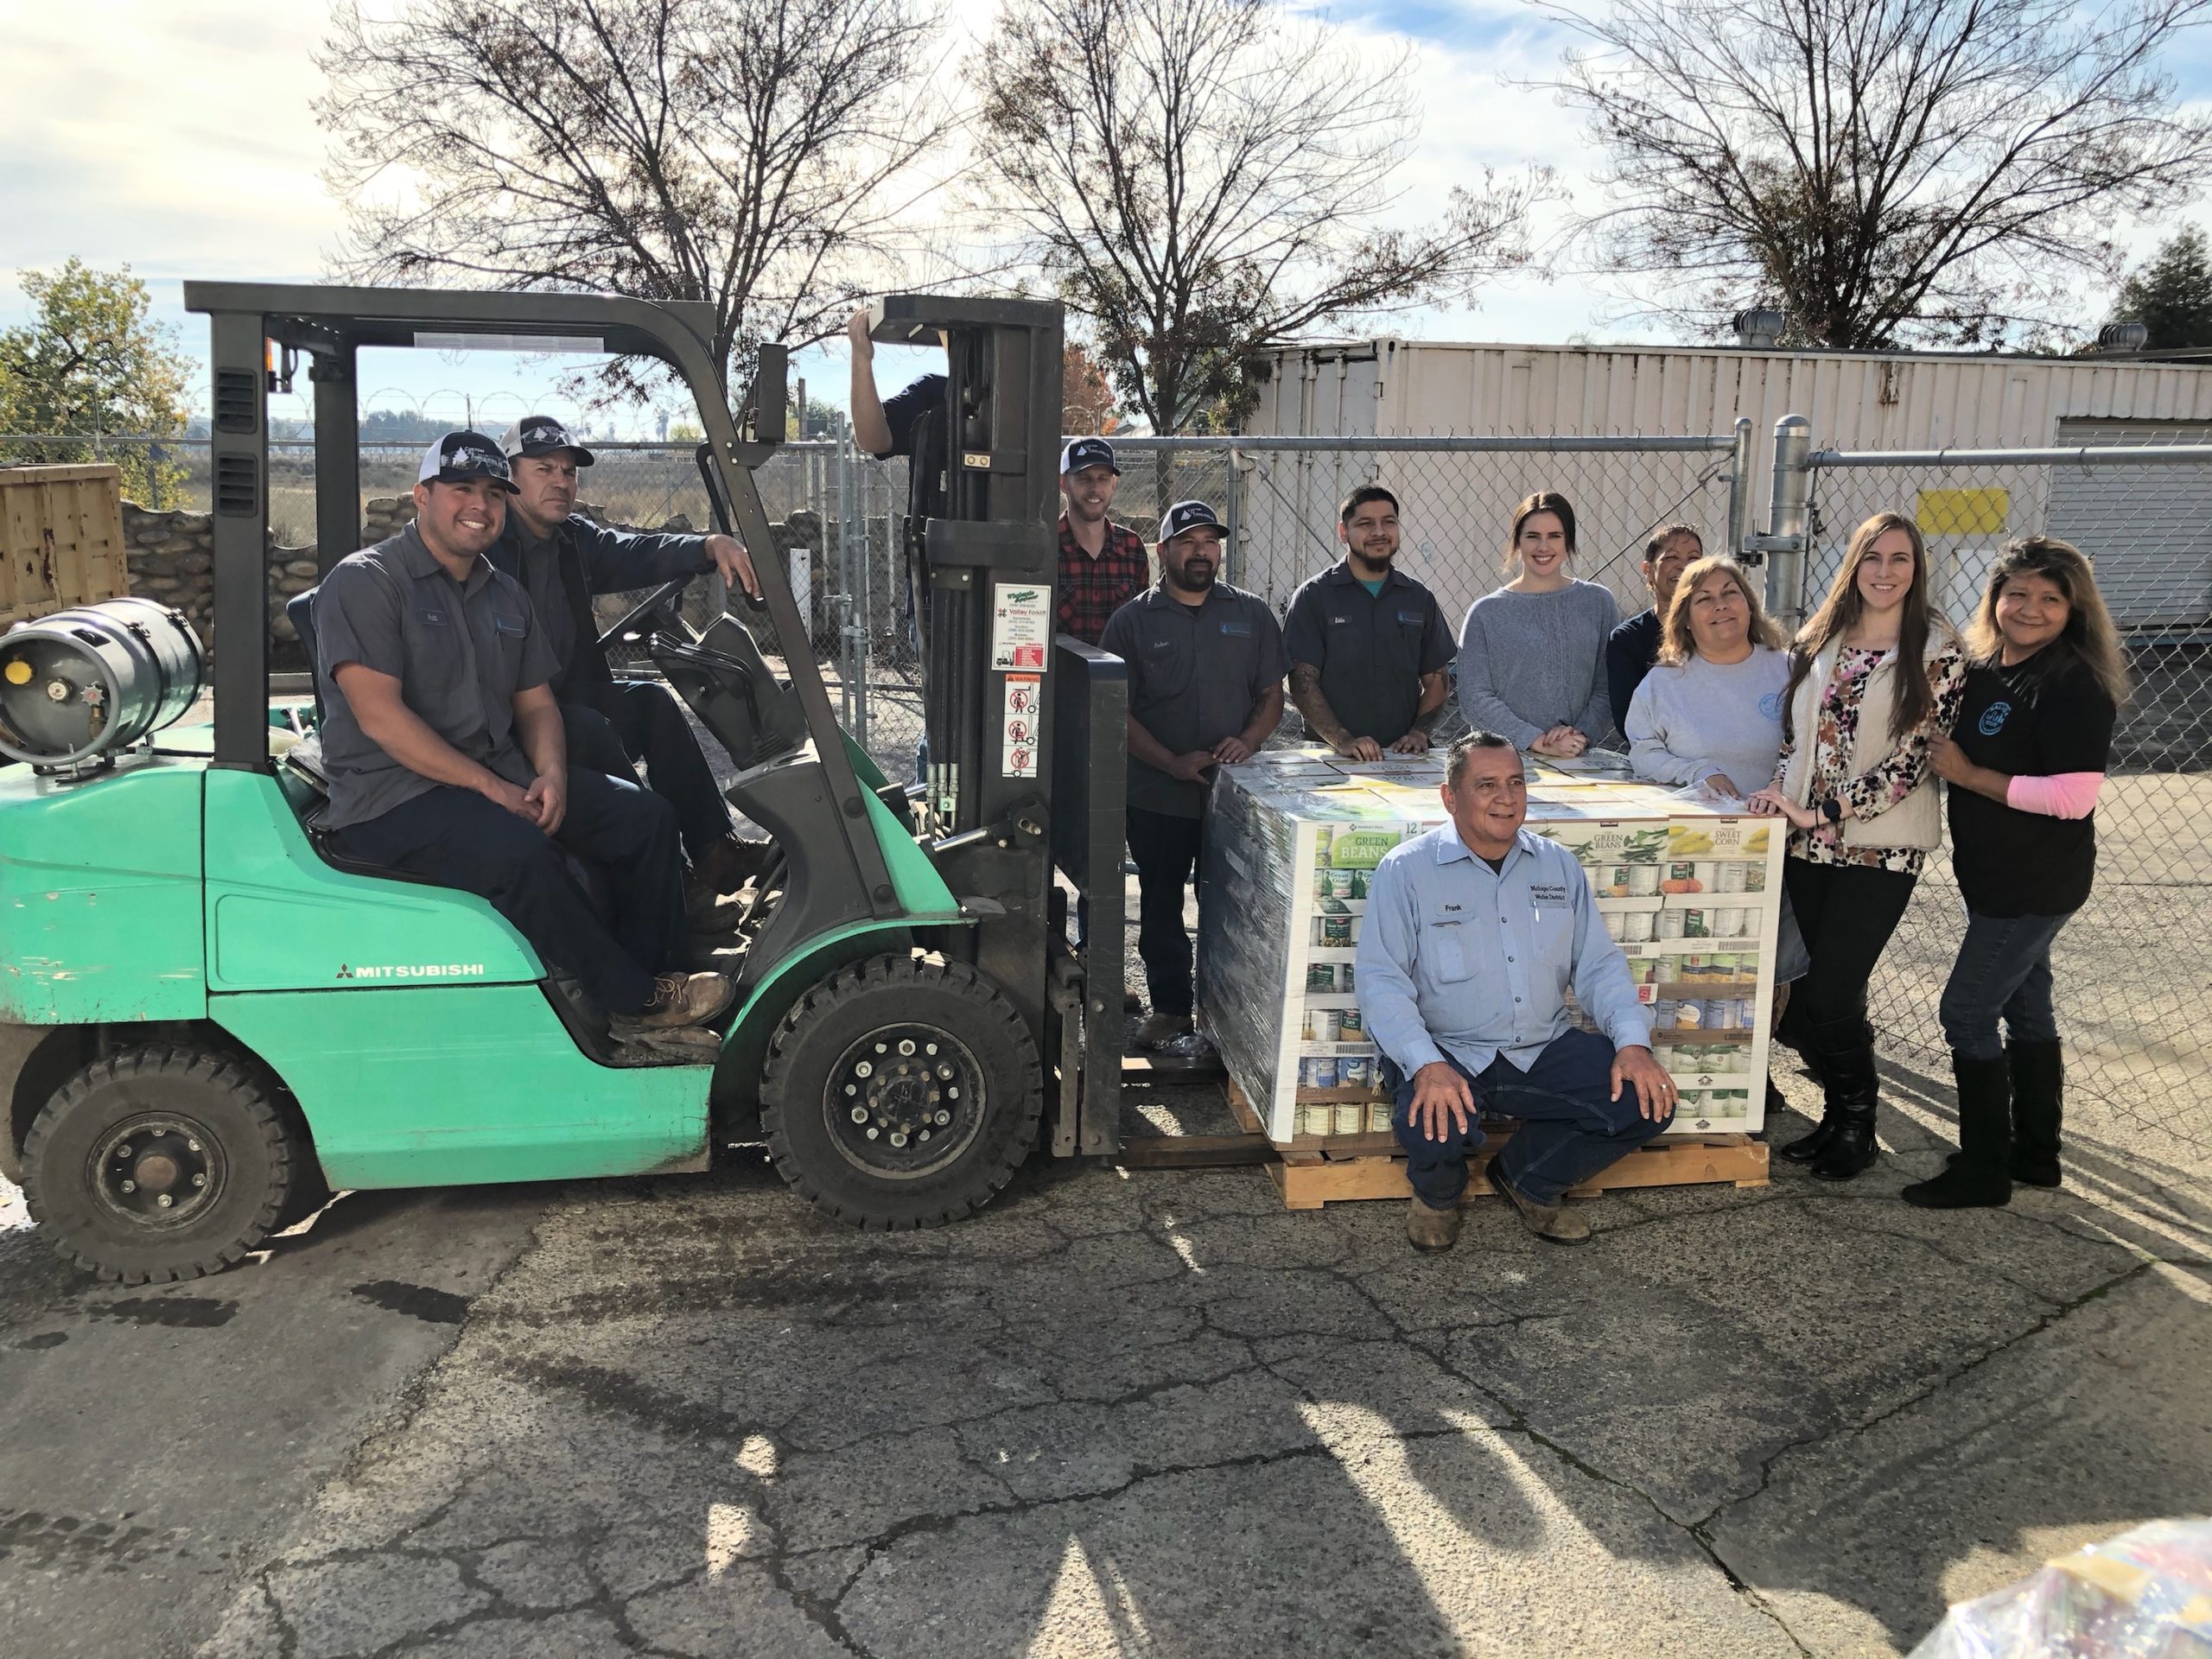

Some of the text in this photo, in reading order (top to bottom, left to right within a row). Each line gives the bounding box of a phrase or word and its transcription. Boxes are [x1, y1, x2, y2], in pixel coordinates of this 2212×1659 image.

[1406, 823, 1417, 834] 12
[1355, 837, 1389, 846] GREEN
[1341, 847, 1388, 859] BEANS
[356, 963, 484, 978] MITSUBISHI
